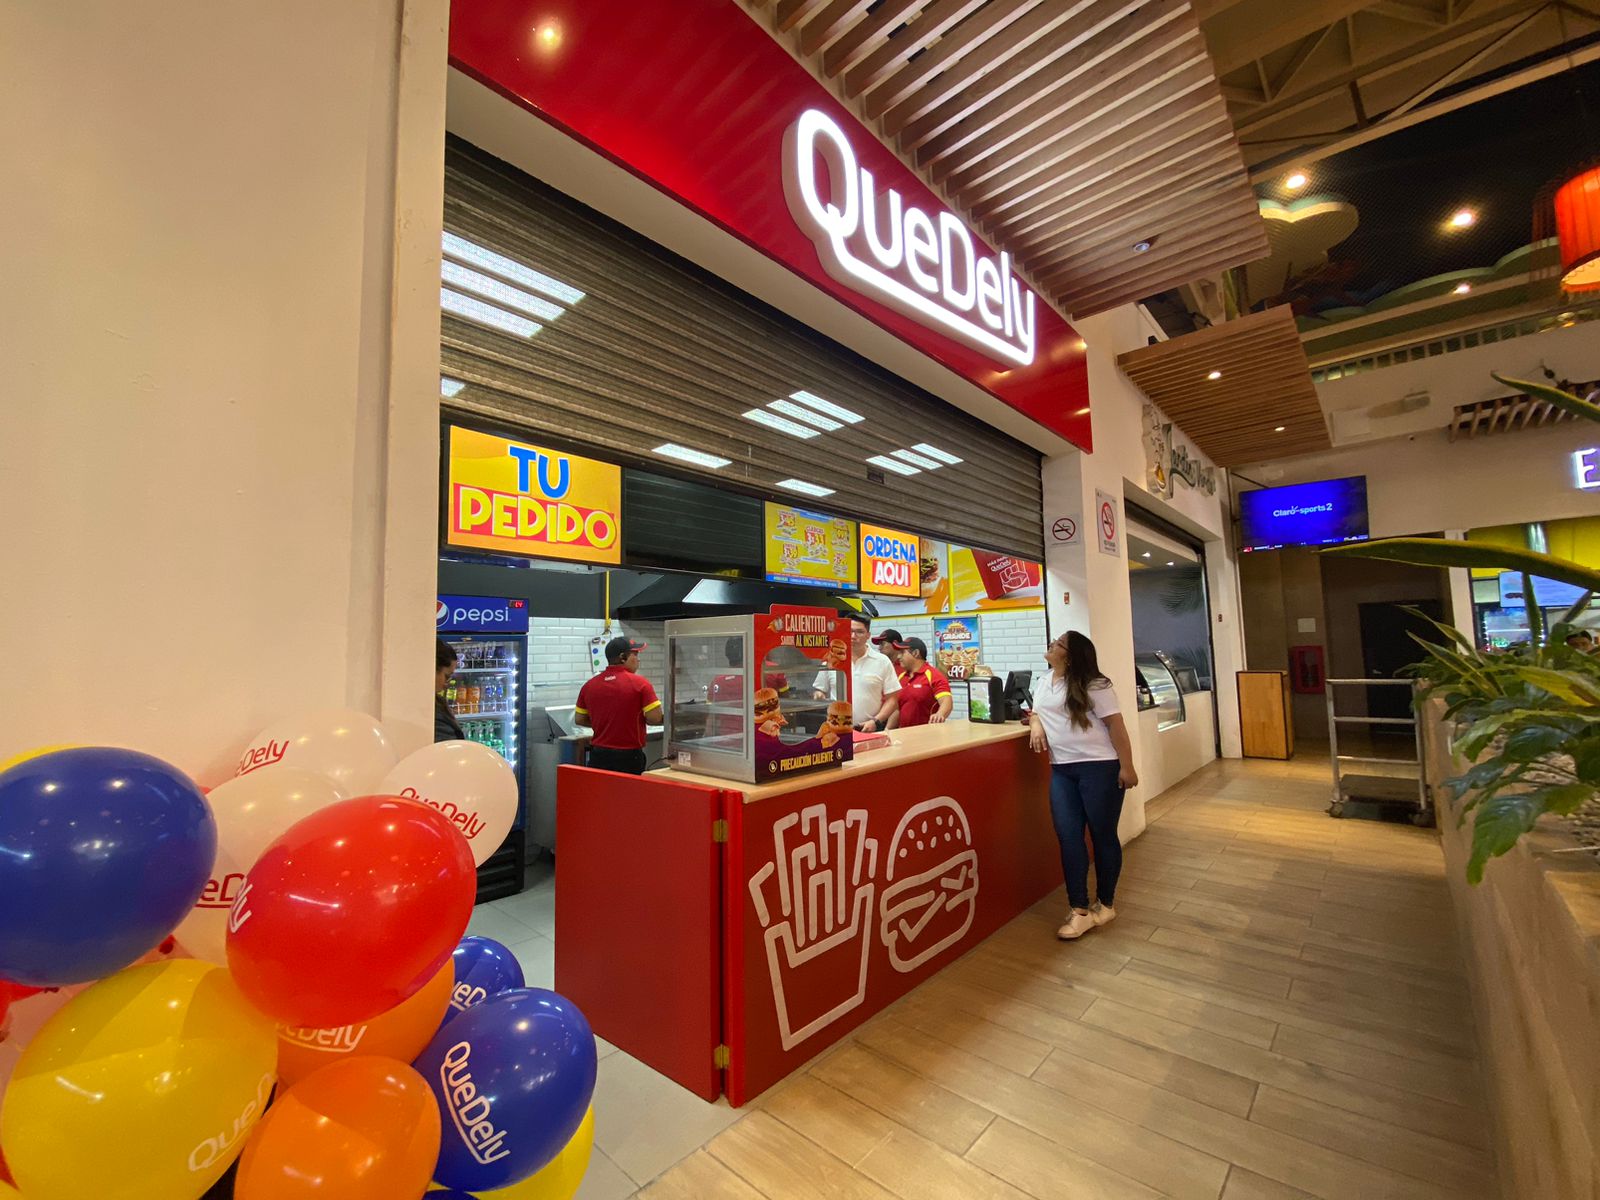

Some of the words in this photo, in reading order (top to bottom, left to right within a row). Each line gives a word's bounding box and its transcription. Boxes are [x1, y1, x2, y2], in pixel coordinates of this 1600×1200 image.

[796, 109, 1035, 366] QueDely
[508, 445, 570, 499] TU
[458, 485, 617, 550] PEDIDO
[863, 535, 917, 564] ORDENA
[453, 606, 509, 625] pepsi
[785, 613, 827, 633] CALIENTITO
[803, 634, 829, 647] INSTANTE
[812, 750, 834, 765] CALIENTE
[439, 1040, 511, 1165] QueDely
